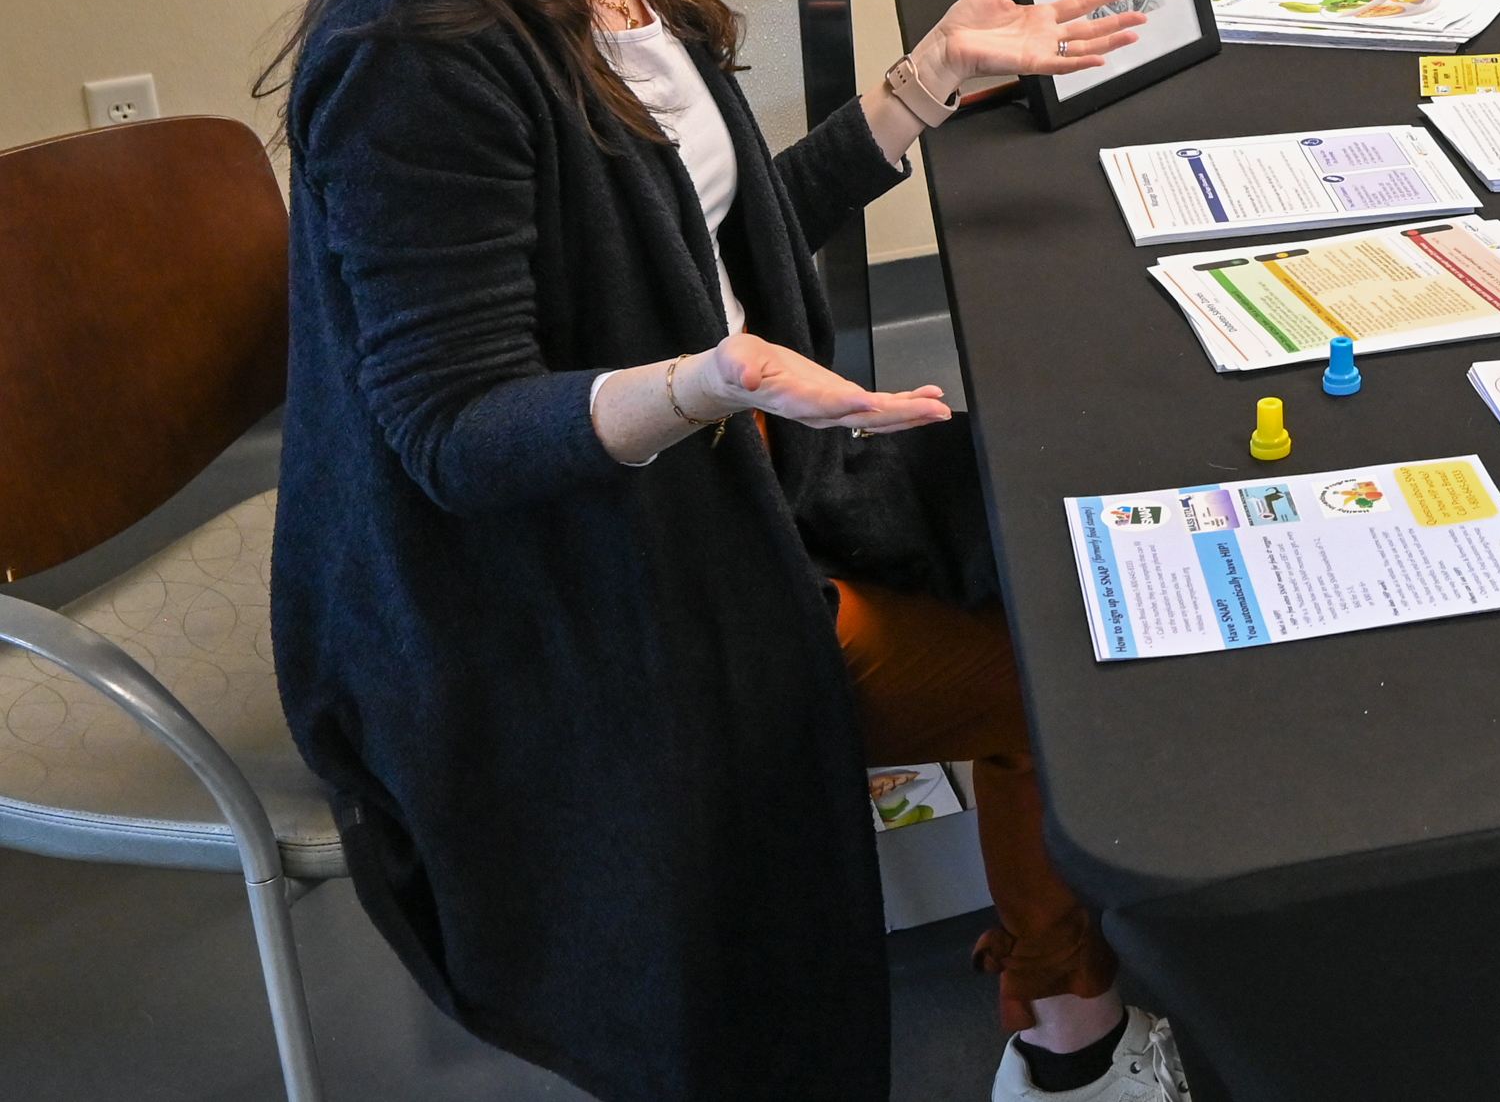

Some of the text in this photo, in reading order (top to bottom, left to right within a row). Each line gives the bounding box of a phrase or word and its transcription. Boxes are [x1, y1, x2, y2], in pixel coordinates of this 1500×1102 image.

[1397, 466, 1436, 524] Questions about SNAP
[1135, 506, 1156, 523] SNAP
[1086, 527, 1099, 538] food
[1089, 539, 1104, 563] (formerly
[1098, 566, 1111, 584] SNAP
[1101, 587, 1115, 597] for
[1217, 543, 1259, 639] You automatically have HIP!
[1105, 598, 1118, 607] up
[1109, 609, 1121, 623] sign
[1216, 599, 1239, 641] Have SNAP?
[1113, 636, 1127, 652] How
